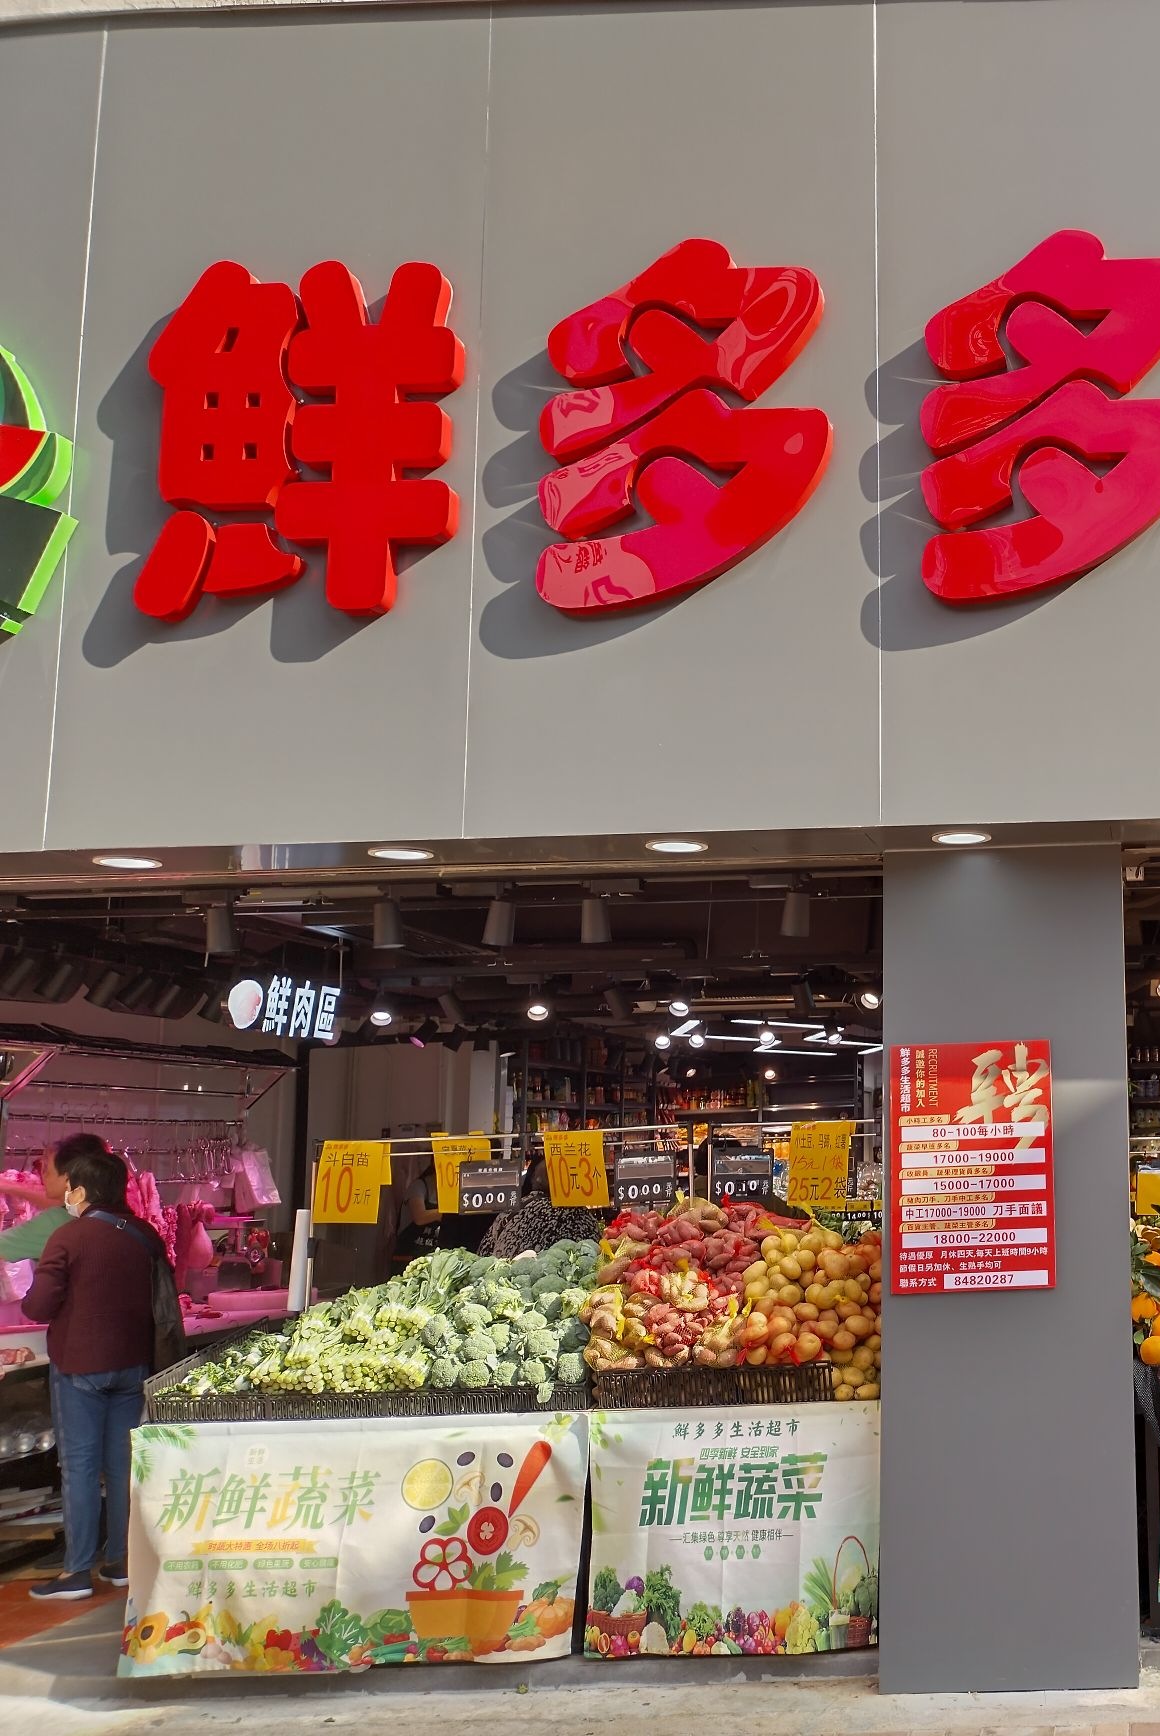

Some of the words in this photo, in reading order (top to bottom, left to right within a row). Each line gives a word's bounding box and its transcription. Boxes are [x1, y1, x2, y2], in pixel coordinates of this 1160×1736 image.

[261, 974, 341, 1040] 鮮肉區
[928, 1048, 938, 1108] RECRUITMENT
[932, 1124, 1015, 1138] 80-100每小時
[549, 1142, 591, 1156] 西兰花
[324, 1151, 369, 1168] 斗白苗
[933, 1151, 1015, 1165] 17000-19000
[617, 1183, 661, 1200] $0.00
[788, 1176, 847, 1202] 25元2袋
[933, 1178, 1015, 1191] 15000-17000
[462, 1192, 505, 1208] $0.00
[992, 1203, 1043, 1217] 刀手面議
[933, 1231, 1016, 1245] 18000-22000
[954, 1274, 1014, 1287] 84820287
[638, 1451, 828, 1527] 新鲜蔬菜
[153, 1466, 382, 1533] 新鲜蔬菜
